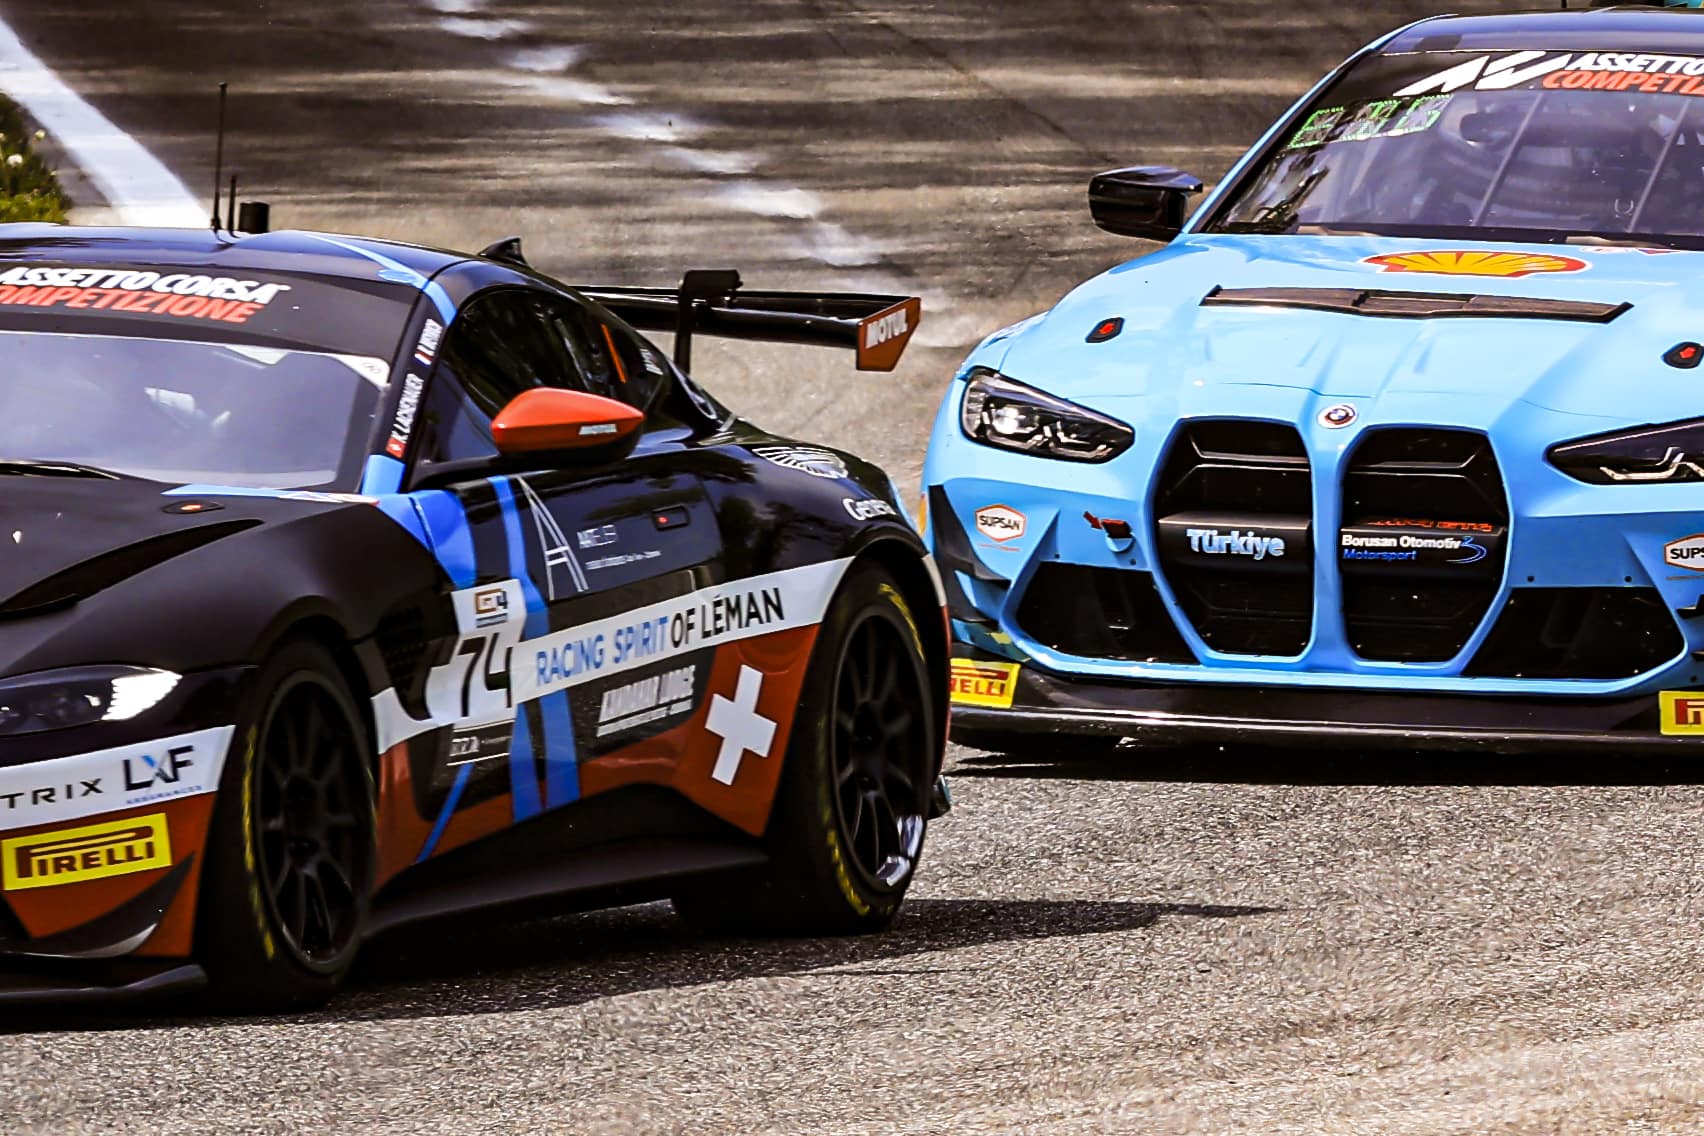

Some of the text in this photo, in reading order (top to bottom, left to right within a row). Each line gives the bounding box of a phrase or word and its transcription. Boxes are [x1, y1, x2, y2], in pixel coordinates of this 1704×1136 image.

[0, 266, 280, 305] ASSETTO CORSA
[865, 308, 908, 350] MOTUL
[979, 515, 1020, 531] SUPSAN
[1341, 535, 1462, 549] Borusan Otomotiv
[1186, 528, 1285, 561] Türkiye
[1343, 549, 1417, 561] Motorsport
[536, 587, 785, 688] RACING SPIRIT OF LÉMAN
[458, 632, 514, 718] 74
[15, 825, 156, 878] PIRELLI
